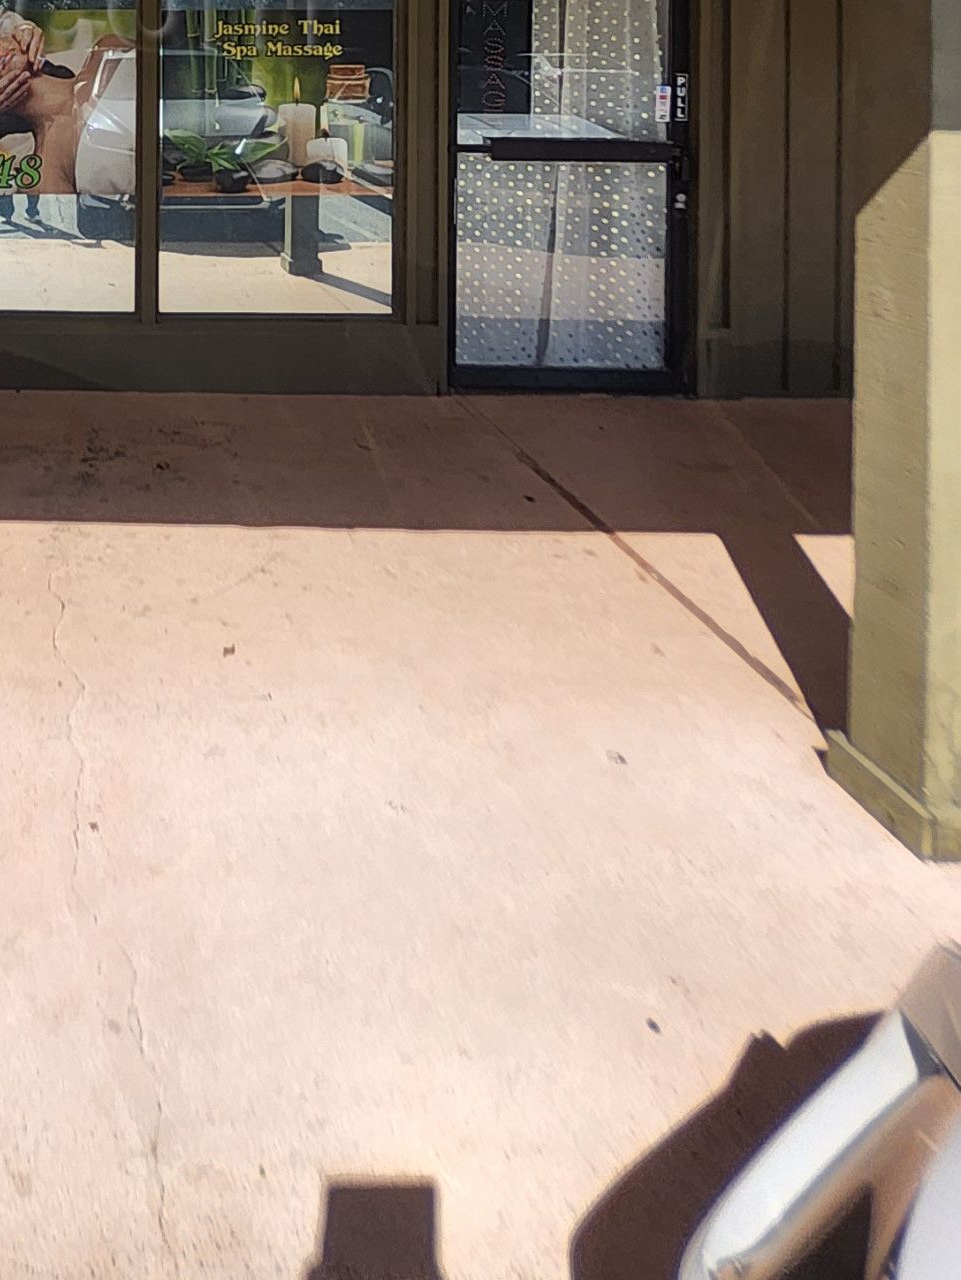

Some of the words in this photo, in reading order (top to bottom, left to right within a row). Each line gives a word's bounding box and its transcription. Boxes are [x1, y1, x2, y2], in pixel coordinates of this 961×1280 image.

[214, 20, 290, 38] Jasmine
[298, 19, 341, 36] Thai
[222, 42, 258, 60] Spa
[266, 41, 343, 60] Massage
[676, 76, 686, 118] PULL
